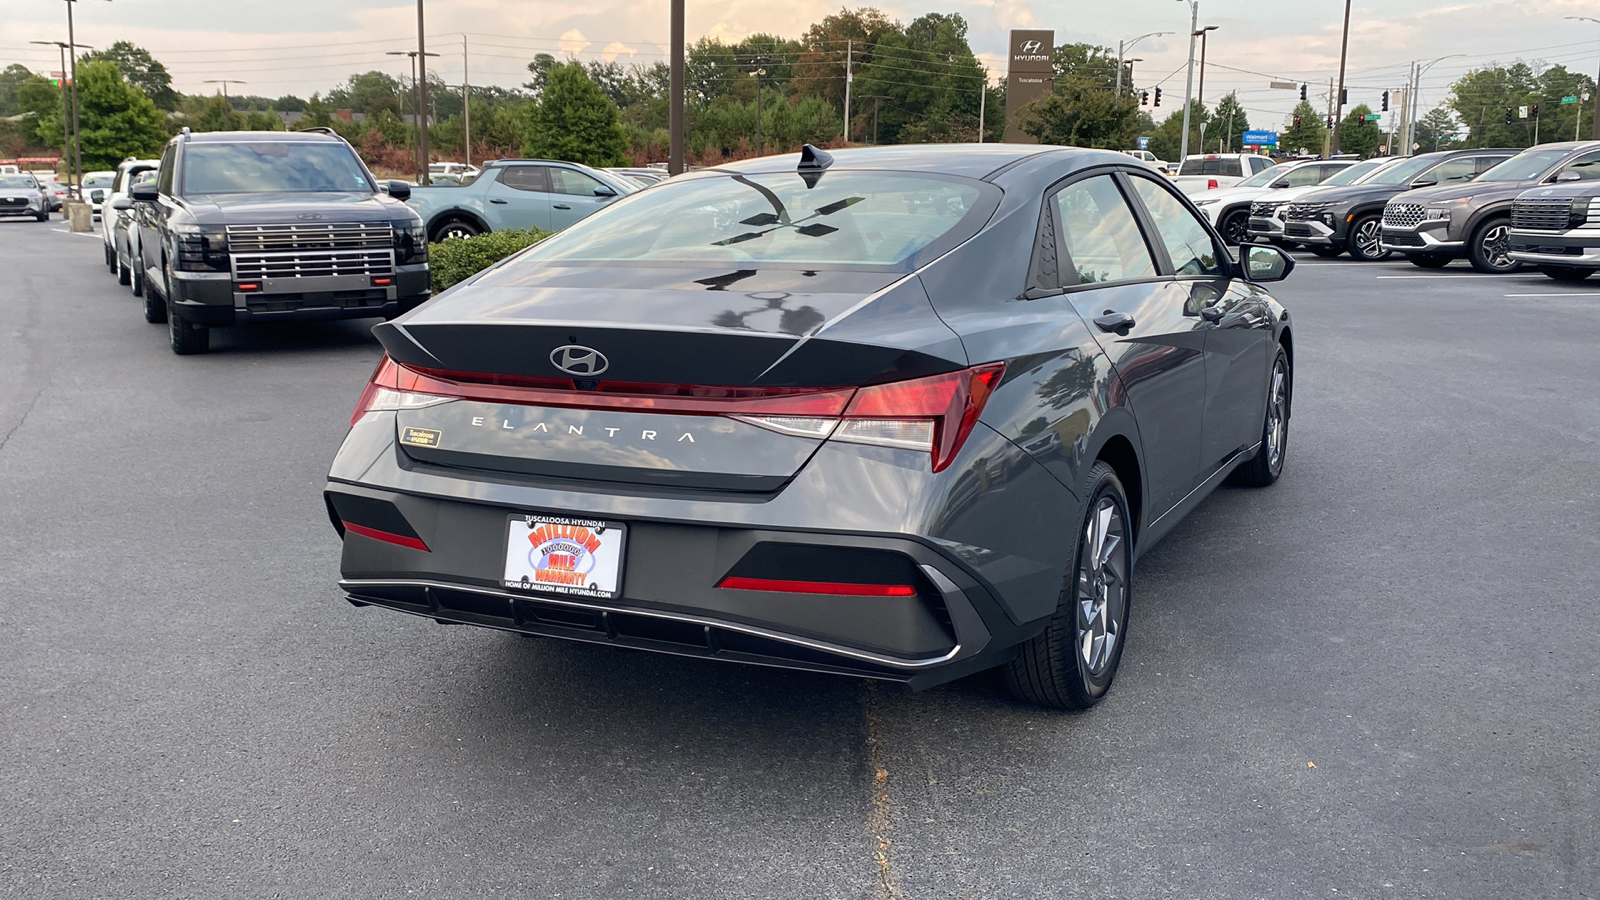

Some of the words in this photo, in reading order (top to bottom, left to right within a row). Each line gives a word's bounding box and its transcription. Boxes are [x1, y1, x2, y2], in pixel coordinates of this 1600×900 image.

[471, 416, 695, 443] ELANTRA
[525, 515, 570, 524] TUSCALOOSA
[571, 519, 605, 527] HYUNDAI
[528, 524, 601, 554] MILLION
[548, 553, 576, 572] MILE
[535, 568, 588, 586] WARRANTY
[505, 581, 522, 589] HOME
[532, 583, 555, 592] MILLION
[555, 586, 568, 594] MILE
[569, 587, 611, 598] HYUNDAI.COM
